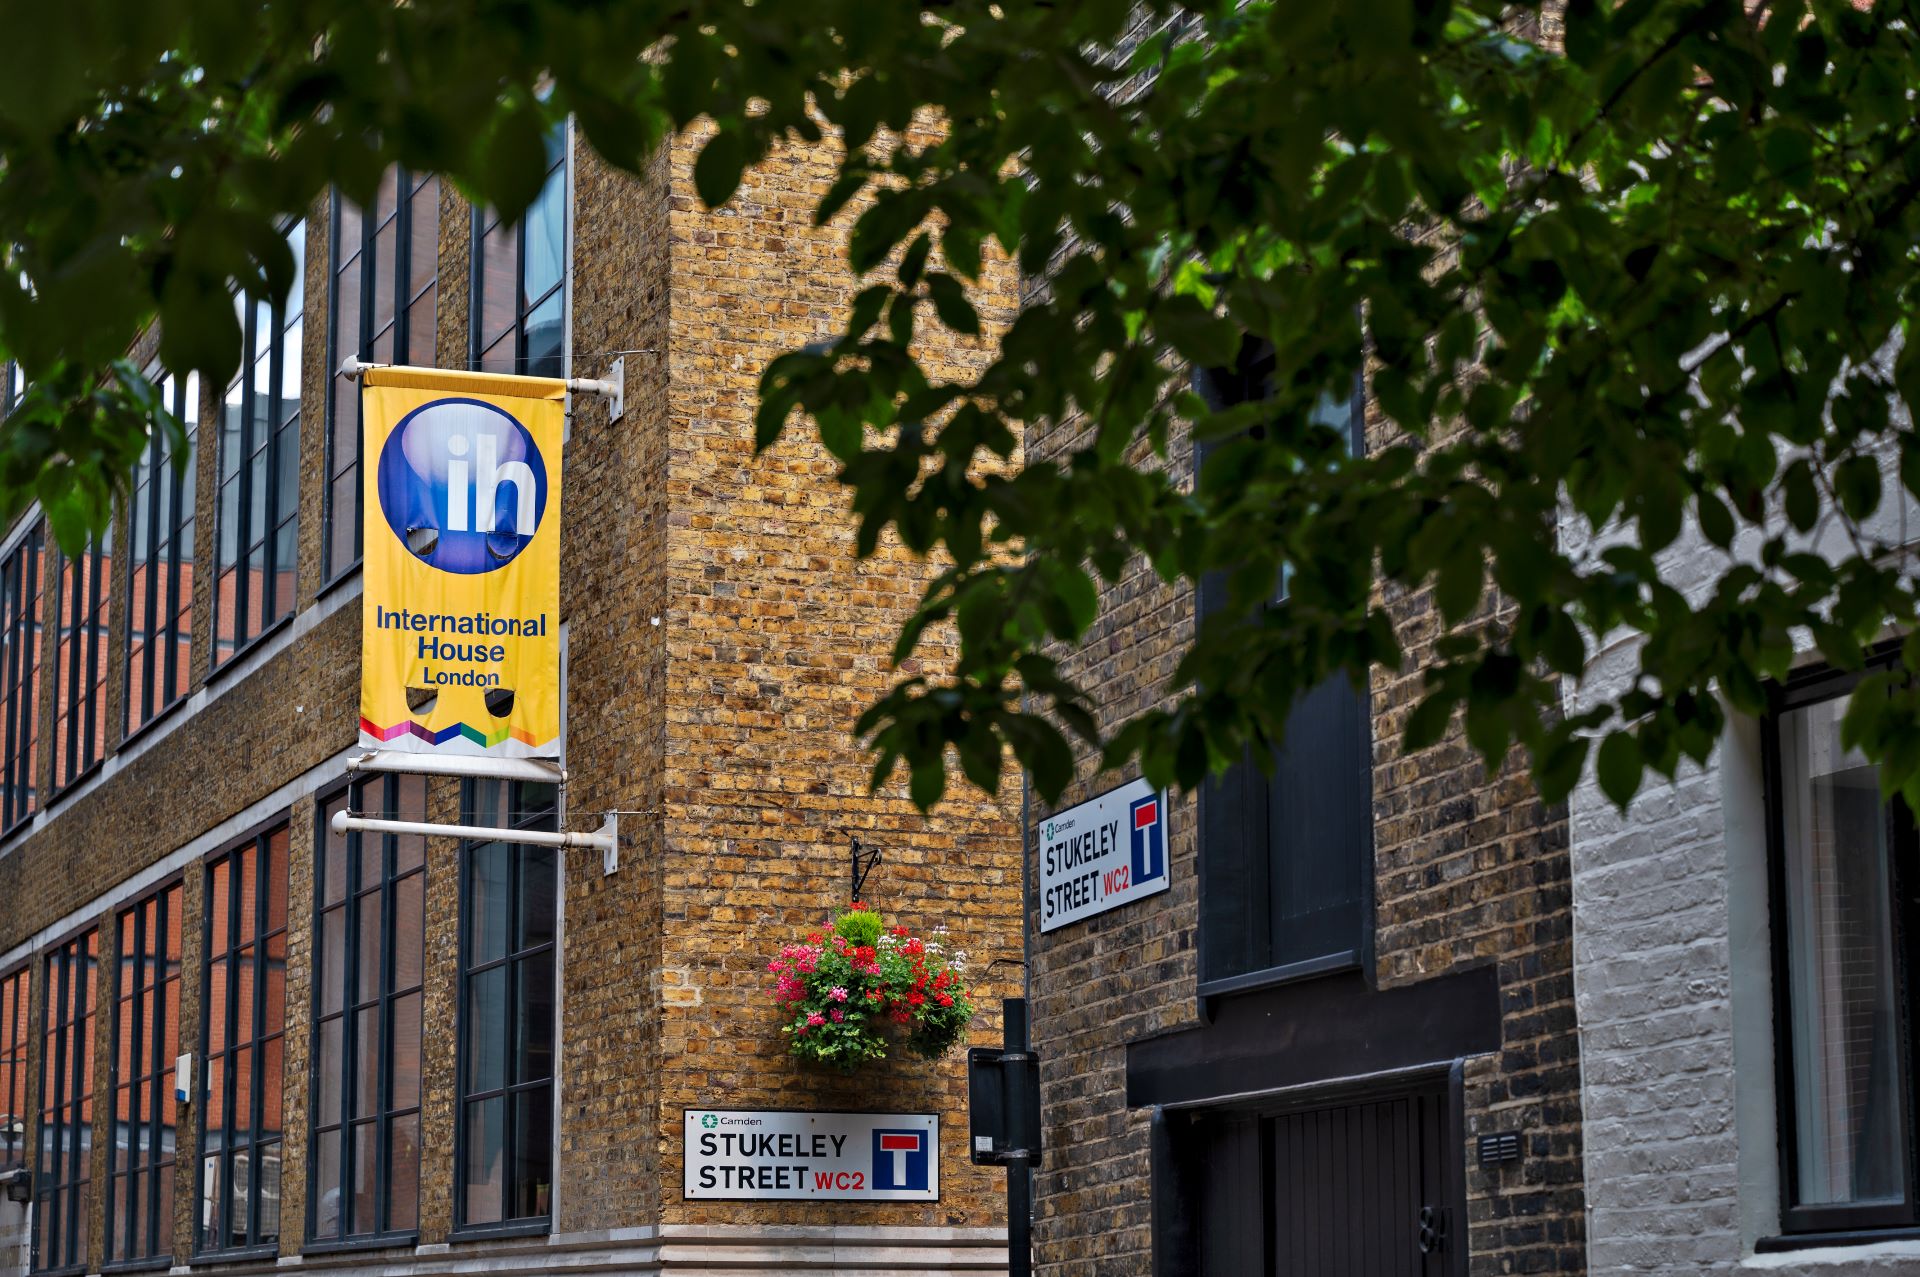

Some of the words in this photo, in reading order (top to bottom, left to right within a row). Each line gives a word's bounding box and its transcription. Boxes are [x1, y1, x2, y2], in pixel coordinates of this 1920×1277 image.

[447, 434, 536, 536] ih
[377, 605, 546, 637] International
[417, 636, 505, 662] House
[423, 667, 500, 687] London
[1055, 819, 1075, 834] Camden
[1046, 820, 1119, 877] STUKELEY
[1046, 870, 1099, 918] STREET
[1103, 865, 1129, 896] WC2
[720, 1117, 762, 1126] Camden
[699, 1133, 848, 1158] STUKELEY
[699, 1165, 809, 1189] STREET
[815, 1171, 865, 1190] WC2
